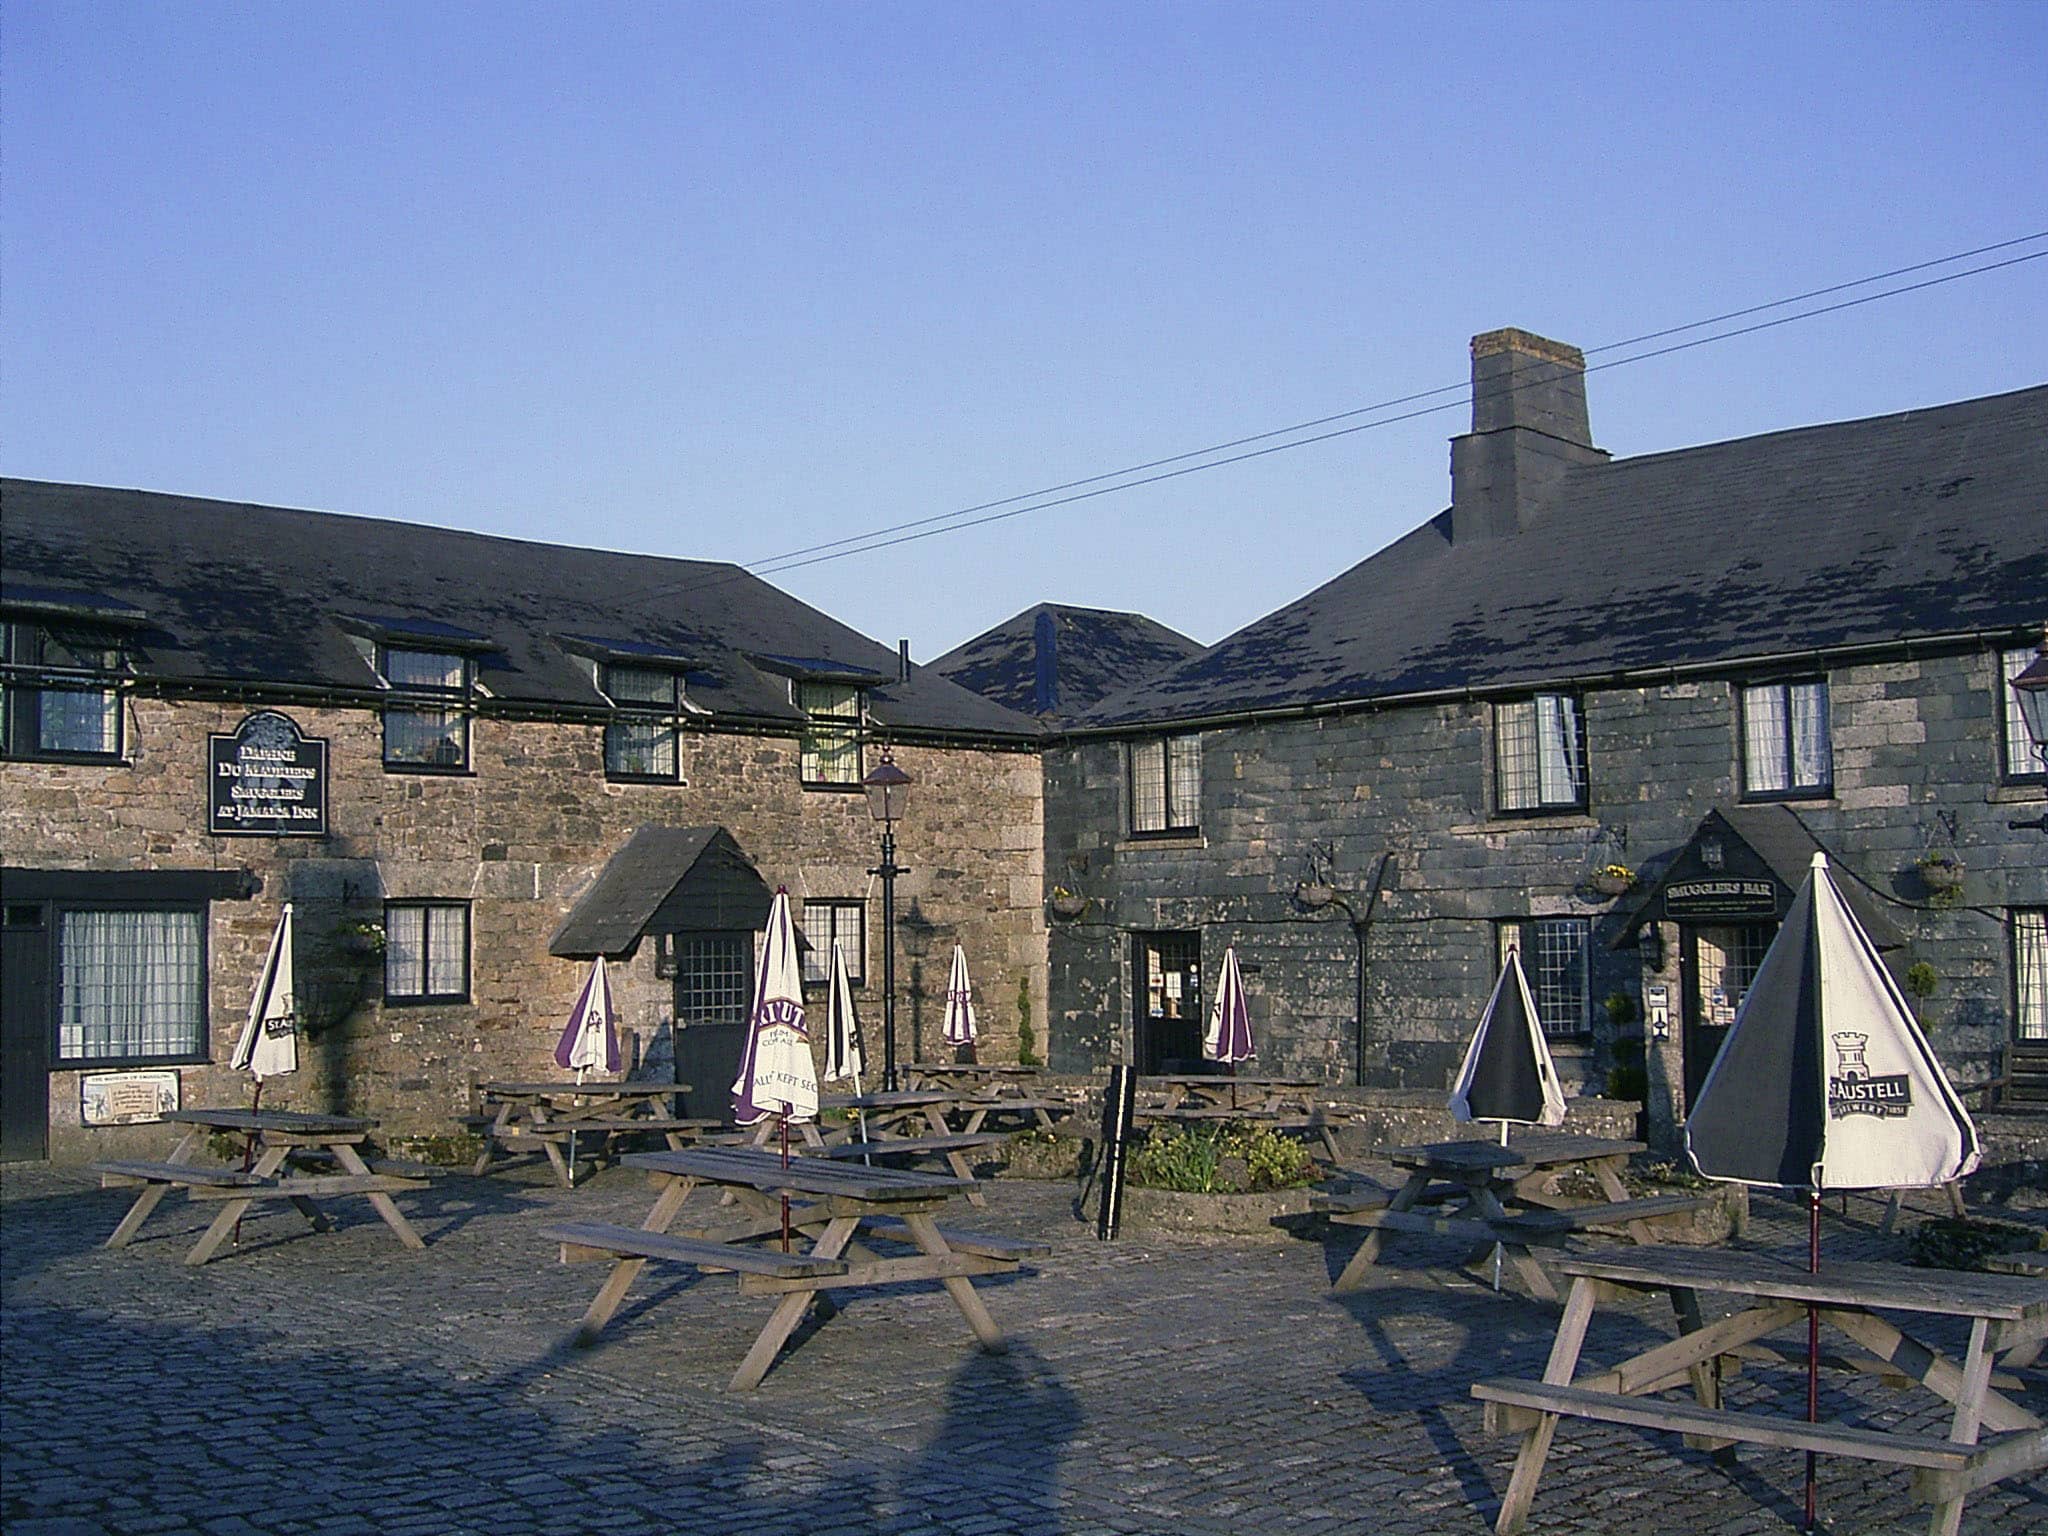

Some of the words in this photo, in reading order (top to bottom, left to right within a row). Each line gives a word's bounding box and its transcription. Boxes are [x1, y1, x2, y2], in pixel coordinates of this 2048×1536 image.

[240, 746, 297, 762] DAPHNE
[218, 762, 241, 777] DU
[244, 764, 316, 779] MAURIERS
[231, 785, 304, 800] SMUGGLERS
[217, 805, 234, 818] AT
[235, 804, 291, 820] JAMAICA
[292, 805, 319, 819] INN
[1667, 883, 1741, 899] SMUGGLERS
[1743, 883, 1772, 897] BAR
[777, 1072, 799, 1087] KEPT
[800, 1079, 817, 1093] SEC
[1838, 1081, 1905, 1099] AUSTELL
